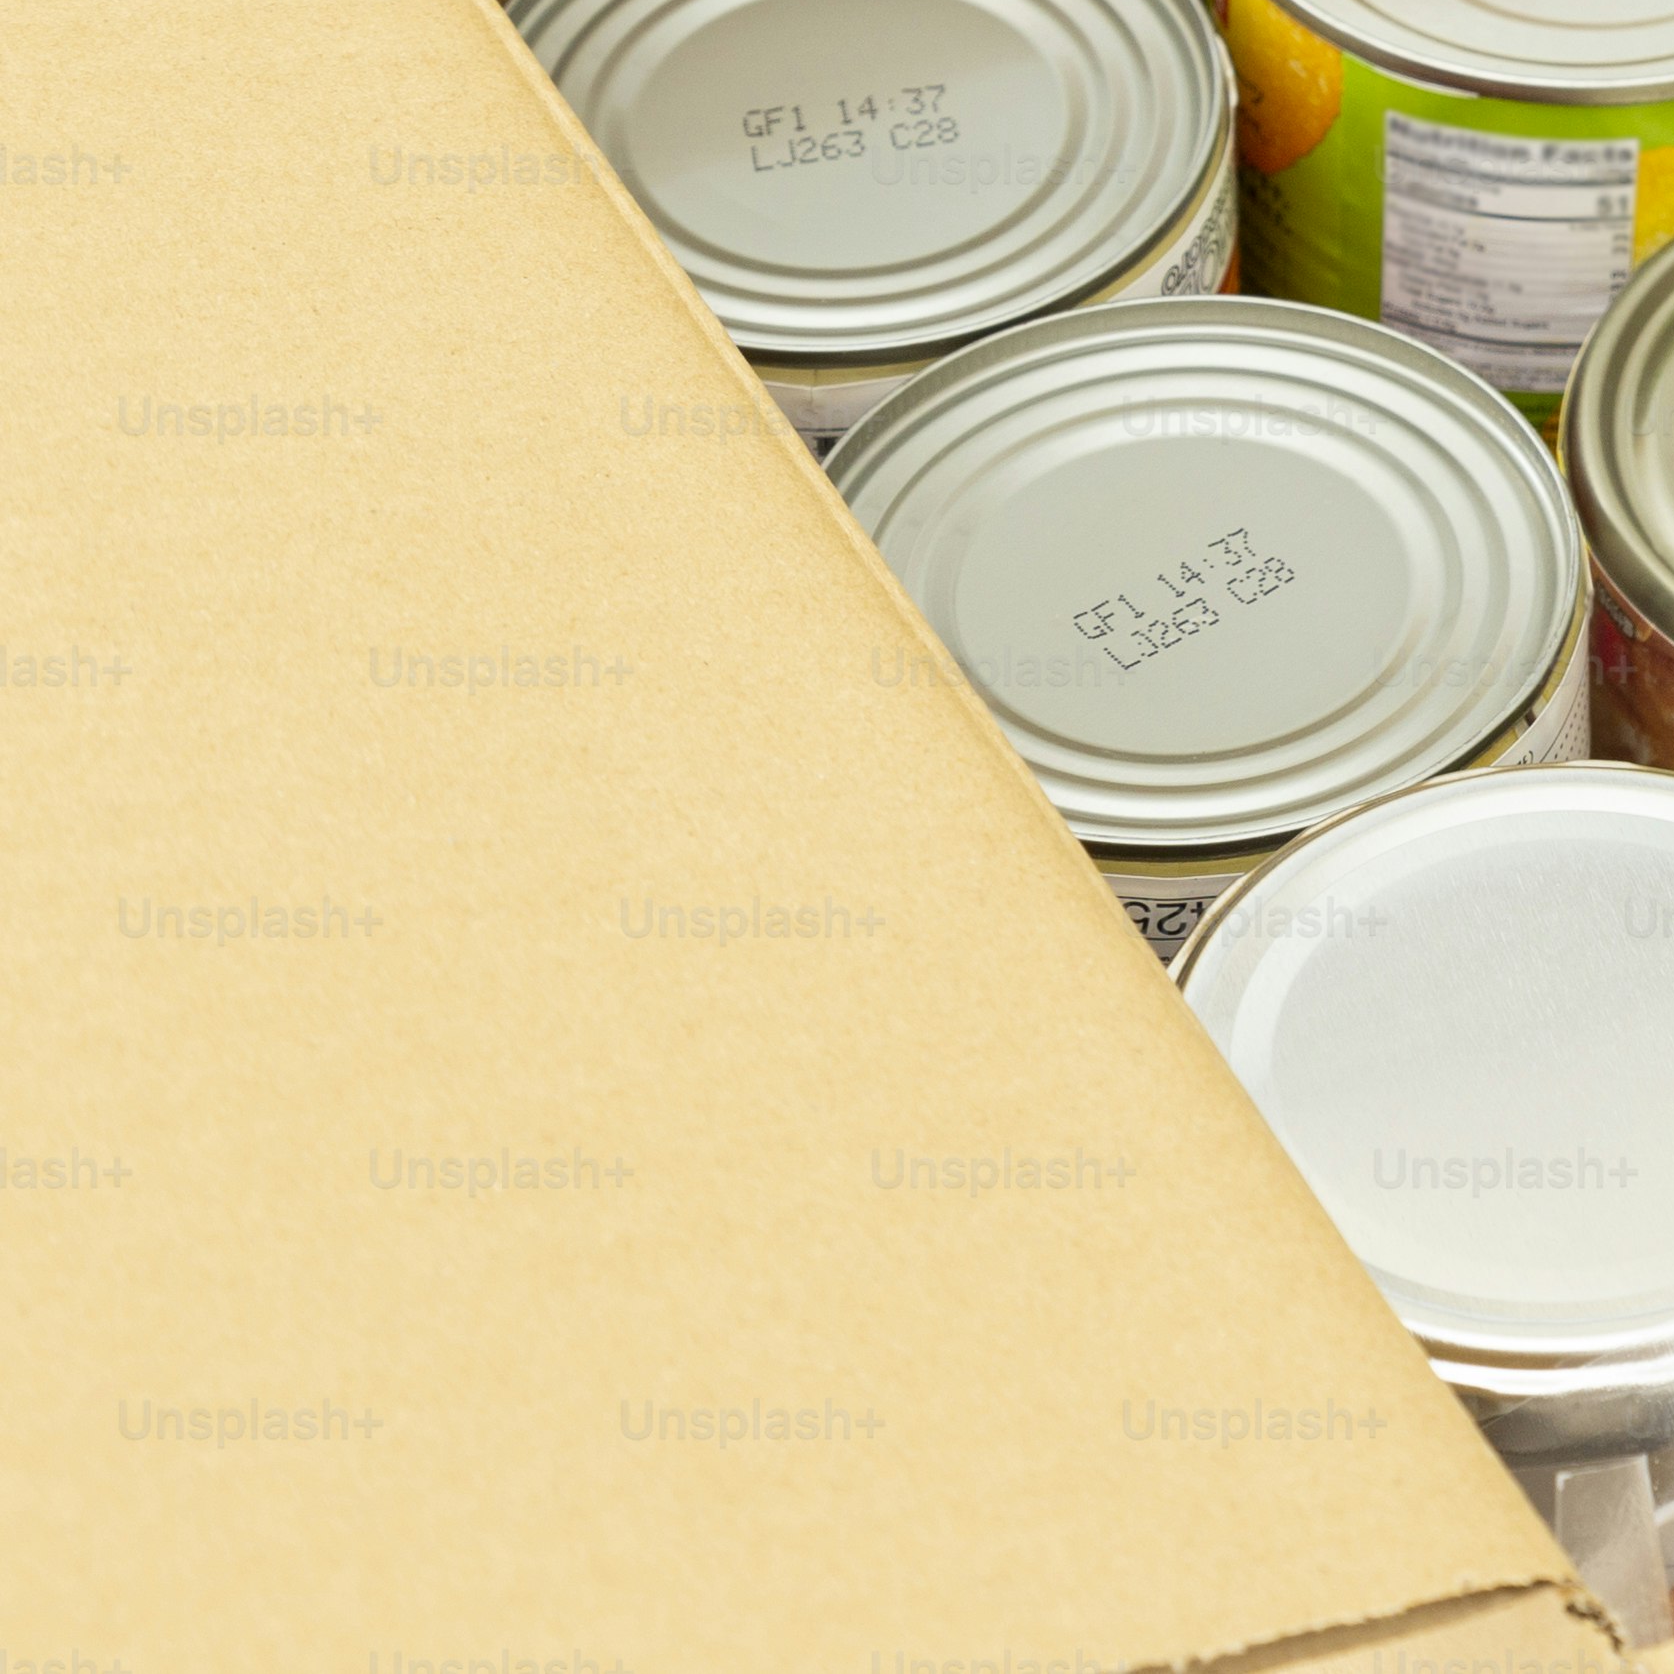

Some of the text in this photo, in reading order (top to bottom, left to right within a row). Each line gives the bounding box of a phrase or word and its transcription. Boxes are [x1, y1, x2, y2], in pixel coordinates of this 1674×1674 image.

[742, 84, 945, 138] GF1 14:37
[751, 117, 959, 172] LJ263 C28
[1073, 527, 1255, 639] GF1 14:37
[1103, 557, 1294, 670] LJ263 C28
